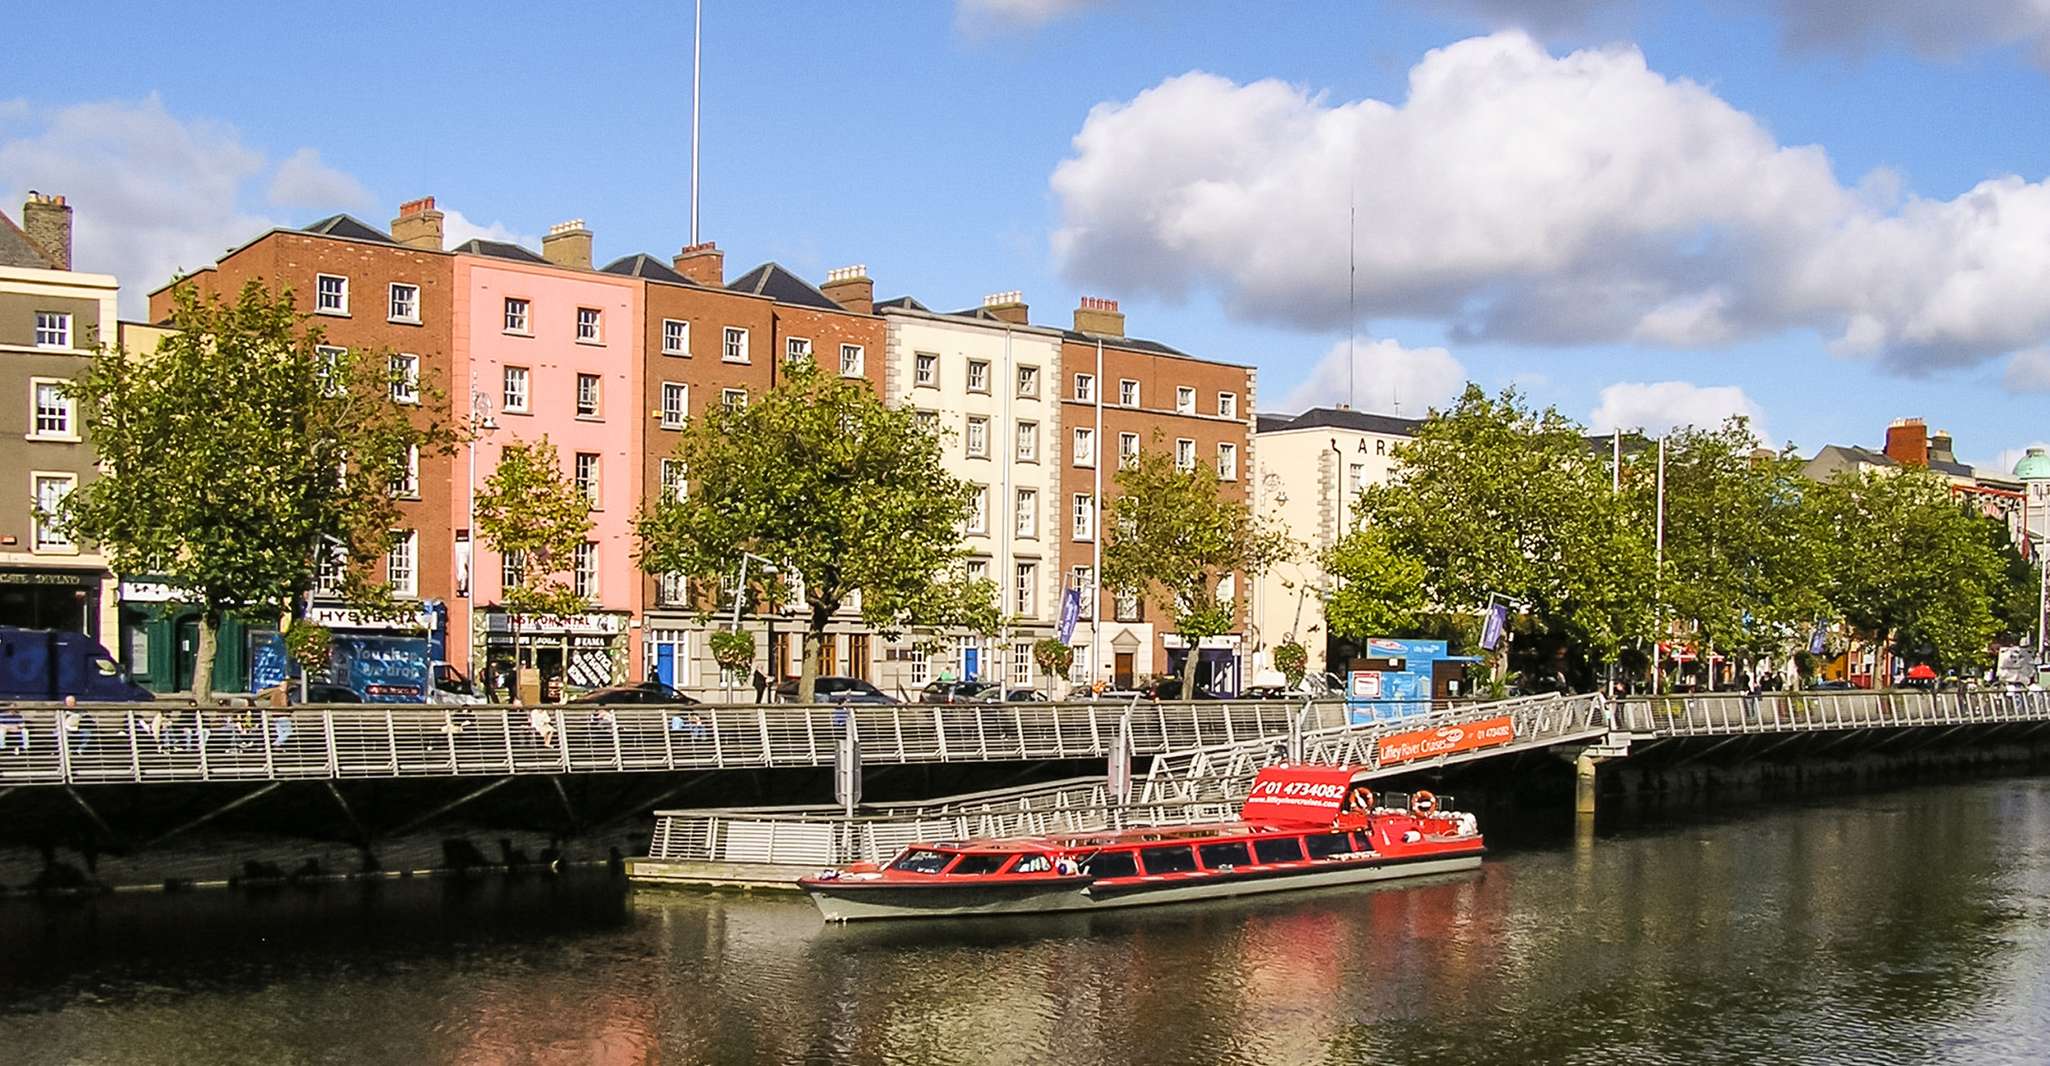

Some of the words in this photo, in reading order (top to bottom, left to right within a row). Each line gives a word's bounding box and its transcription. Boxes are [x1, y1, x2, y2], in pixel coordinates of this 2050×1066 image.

[352, 642, 380, 660] You
[386, 663, 420, 680] drop
[1265, 781, 1282, 795] 01
[1283, 782, 1346, 798] 4734082
